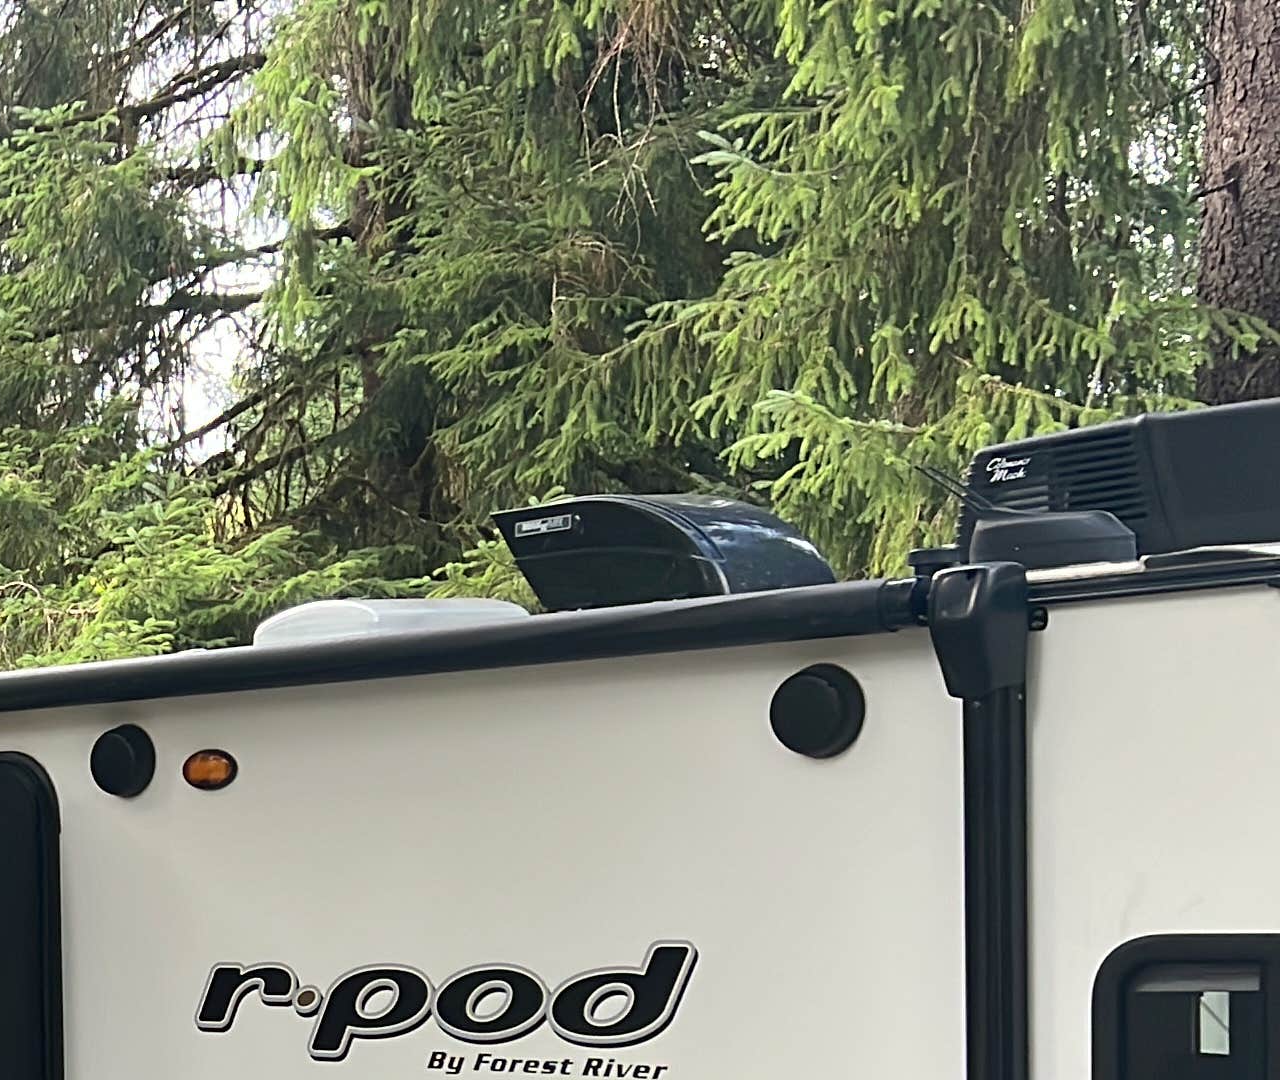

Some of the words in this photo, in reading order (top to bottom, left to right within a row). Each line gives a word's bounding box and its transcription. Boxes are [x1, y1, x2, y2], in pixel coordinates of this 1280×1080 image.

[427, 1051, 464, 1074] By
[473, 1053, 574, 1076] Forest
[582, 1057, 668, 1080] River
